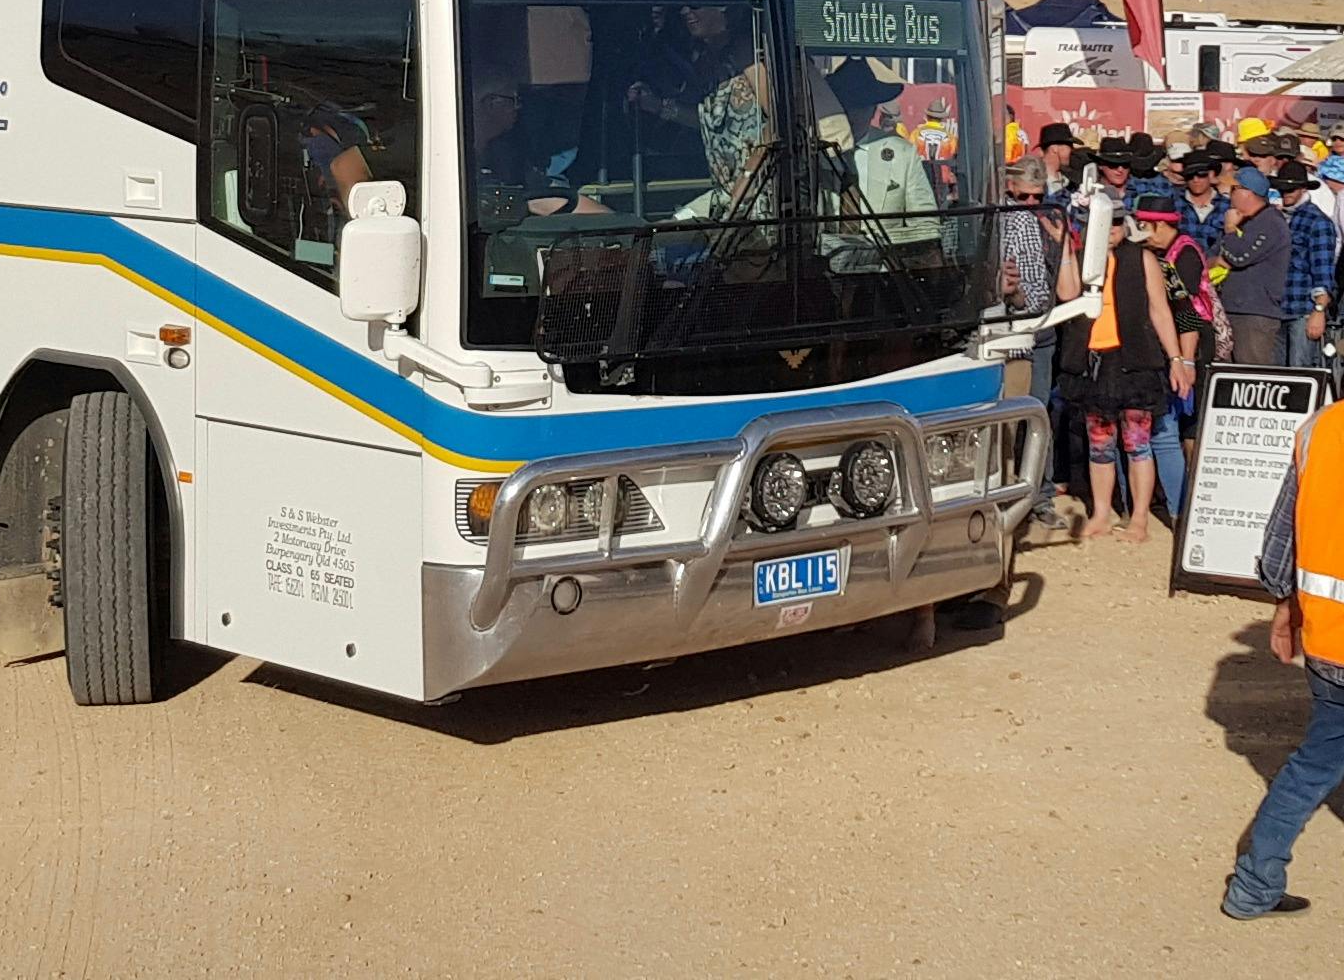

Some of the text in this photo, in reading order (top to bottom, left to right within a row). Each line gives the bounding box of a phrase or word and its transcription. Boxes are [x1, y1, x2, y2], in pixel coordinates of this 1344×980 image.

[822, 0, 940, 44] Shuttle Bus
[267, 516, 316, 537] Investments
[280, 506, 338, 528] S & S Webster
[265, 542, 314, 566] Burpengary
[323, 540, 347, 557] Drive
[265, 559, 293, 575] CLASS
[324, 571, 355, 589] SEATED
